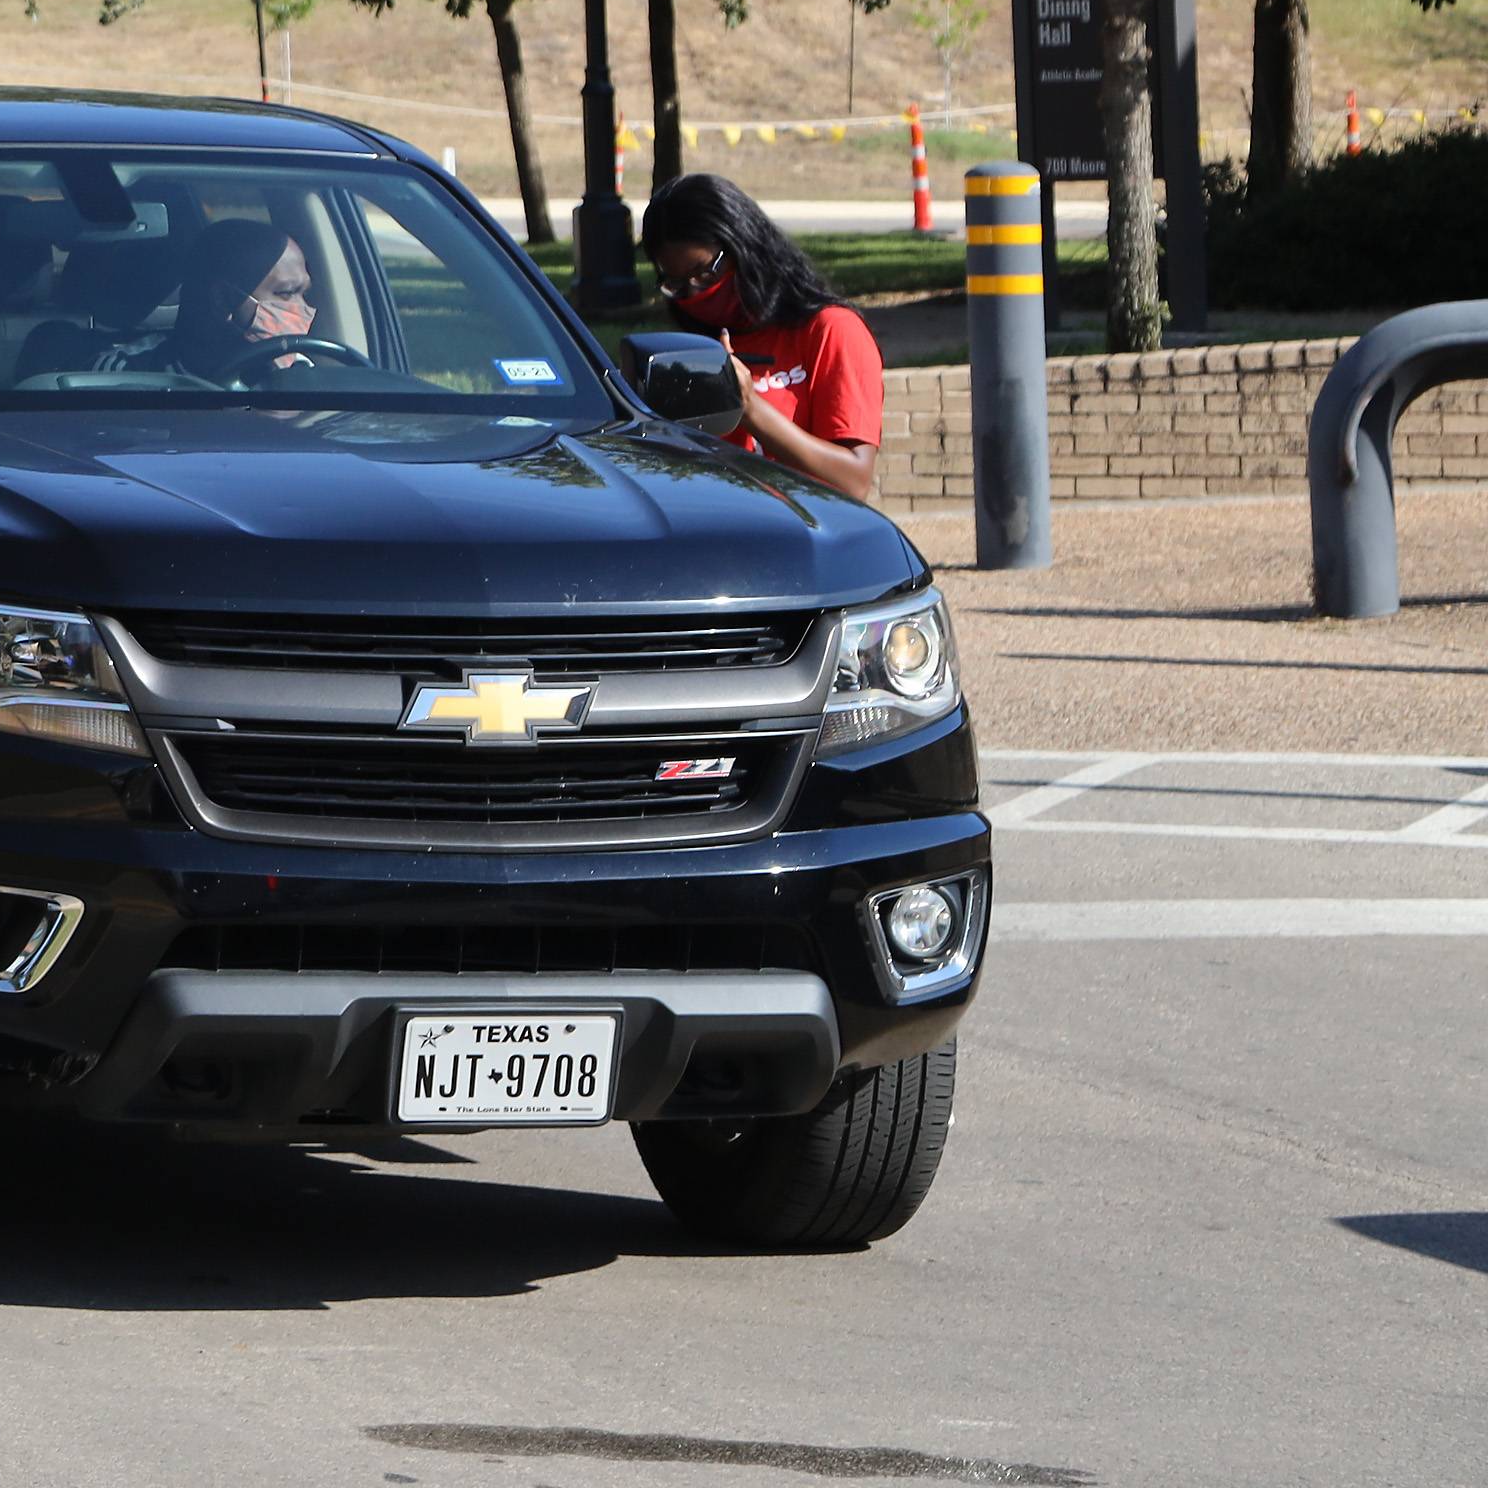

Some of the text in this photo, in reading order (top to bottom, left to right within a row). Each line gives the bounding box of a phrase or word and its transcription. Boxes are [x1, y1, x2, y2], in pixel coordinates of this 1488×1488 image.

[1039, 21, 1071, 46] Hall
[654, 757, 737, 780] Z71
[472, 1025, 550, 1043] TEXAS
